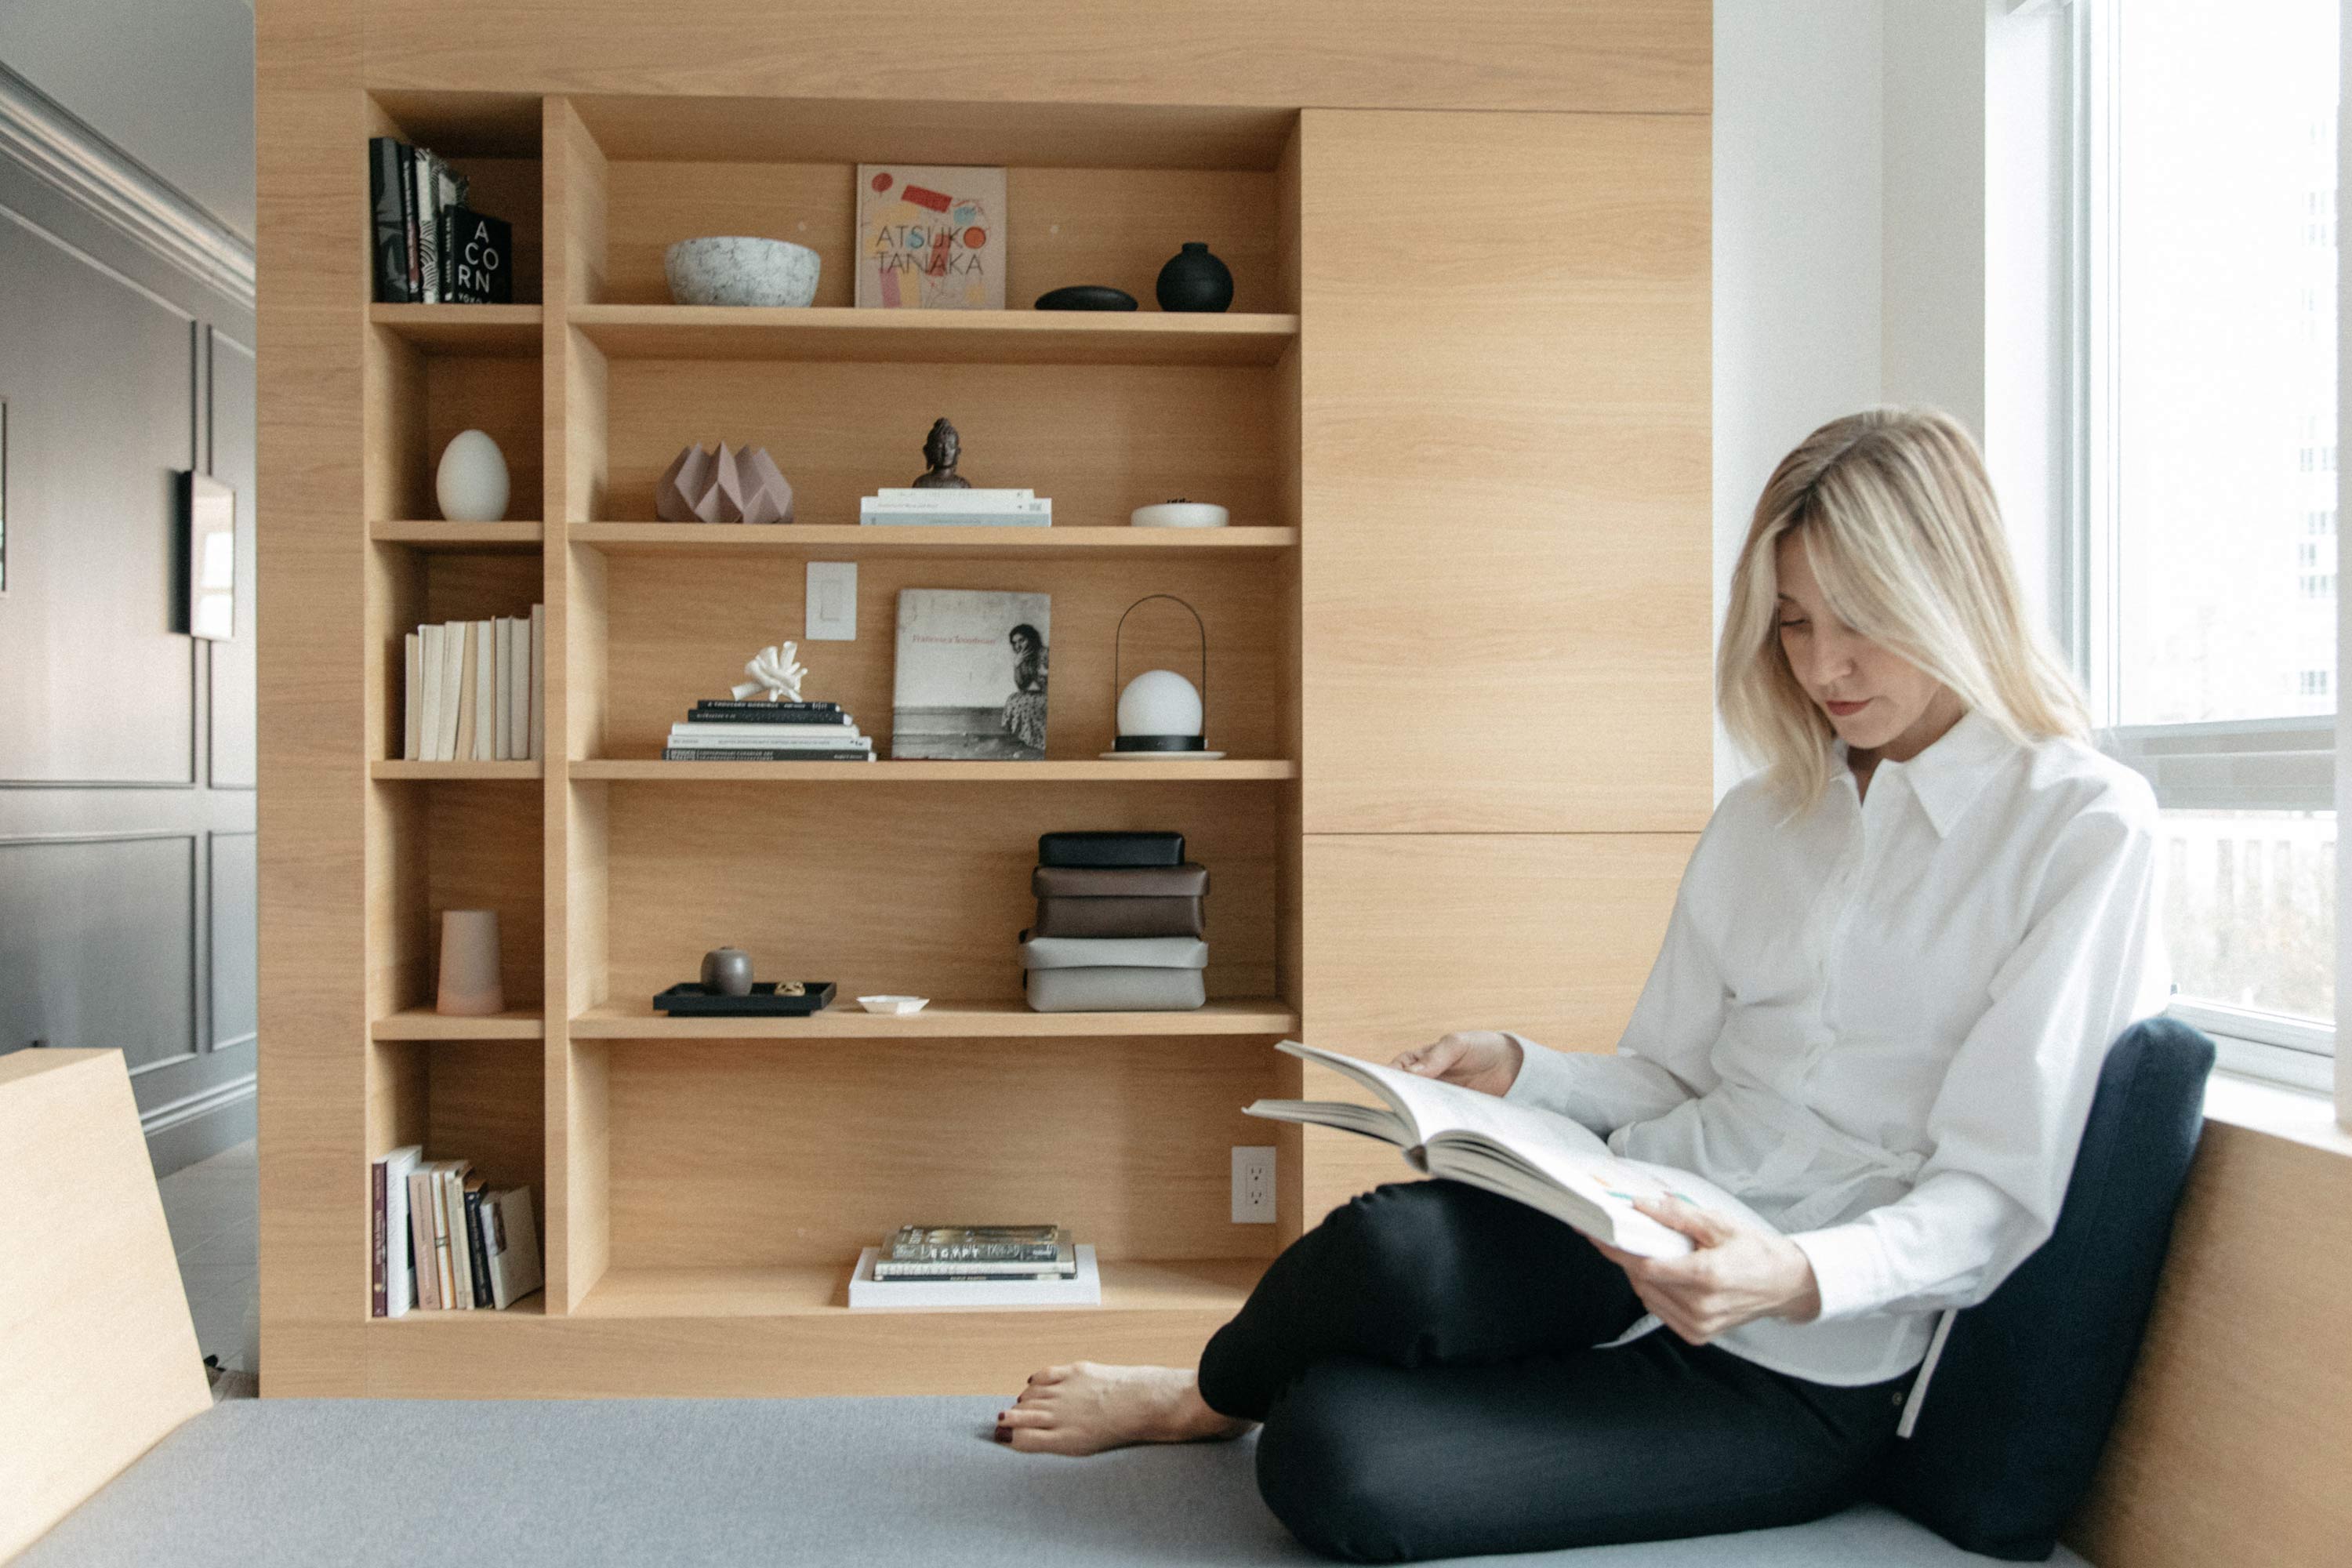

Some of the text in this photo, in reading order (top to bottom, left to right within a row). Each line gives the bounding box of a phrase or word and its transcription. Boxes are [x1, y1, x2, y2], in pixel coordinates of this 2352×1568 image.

[474, 220, 490, 243] A
[877, 225, 987, 249] ATSUKO
[877, 251, 985, 275] TANAKA
